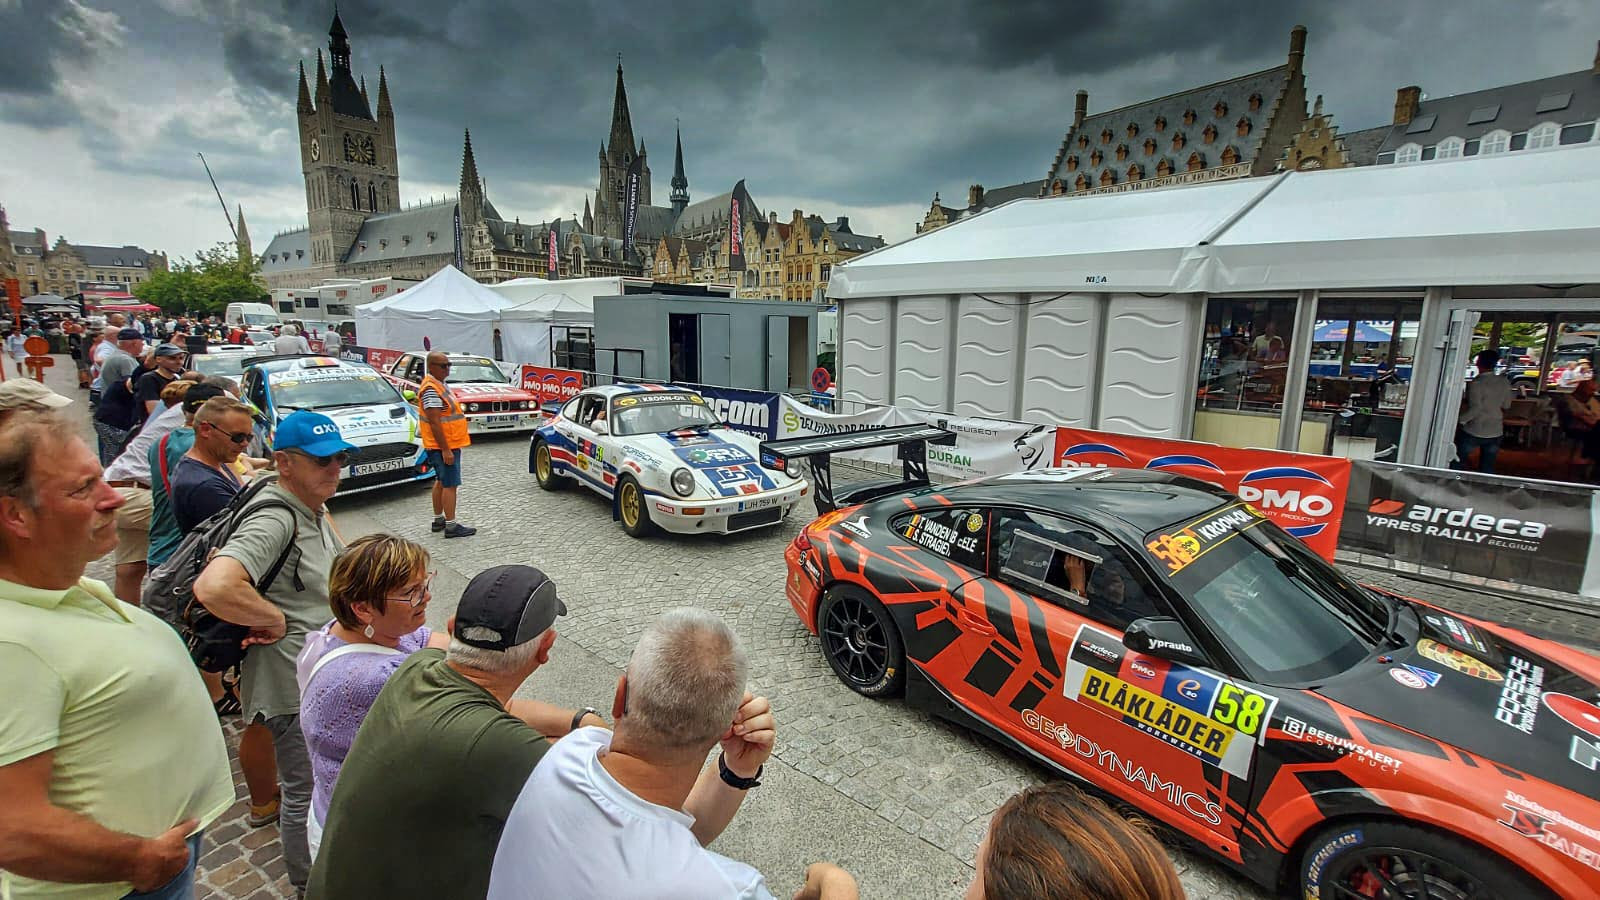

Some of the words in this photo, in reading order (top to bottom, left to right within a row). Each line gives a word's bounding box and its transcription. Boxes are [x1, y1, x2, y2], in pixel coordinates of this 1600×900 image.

[523, 381, 541, 391] PMO
[542, 382, 560, 394] PMO
[561, 385, 581, 397] PMO
[949, 425, 999, 437] PEUGEOT
[622, 445, 663, 466] PORSCHE
[928, 449, 972, 467] DURAN
[759, 499, 770, 508] 759
[925, 519, 950, 541] VANDEN
[1408, 504, 1547, 539] ardeca
[1366, 515, 1423, 534] YPRES
[1424, 525, 1489, 544] RALLY
[1487, 539, 1539, 552] BELGIUM
[1090, 643, 1119, 659] ardeca
[1148, 638, 1193, 653] yprauto
[1131, 663, 1157, 677] PMO
[1085, 675, 1226, 753] BLÅKLÄDER
[1214, 683, 1266, 735] 58
[1137, 722, 1203, 757] WORKWEAR
[1308, 726, 1403, 768] BEEUWSAERT
[1306, 735, 1400, 775] CONSTRUCT
